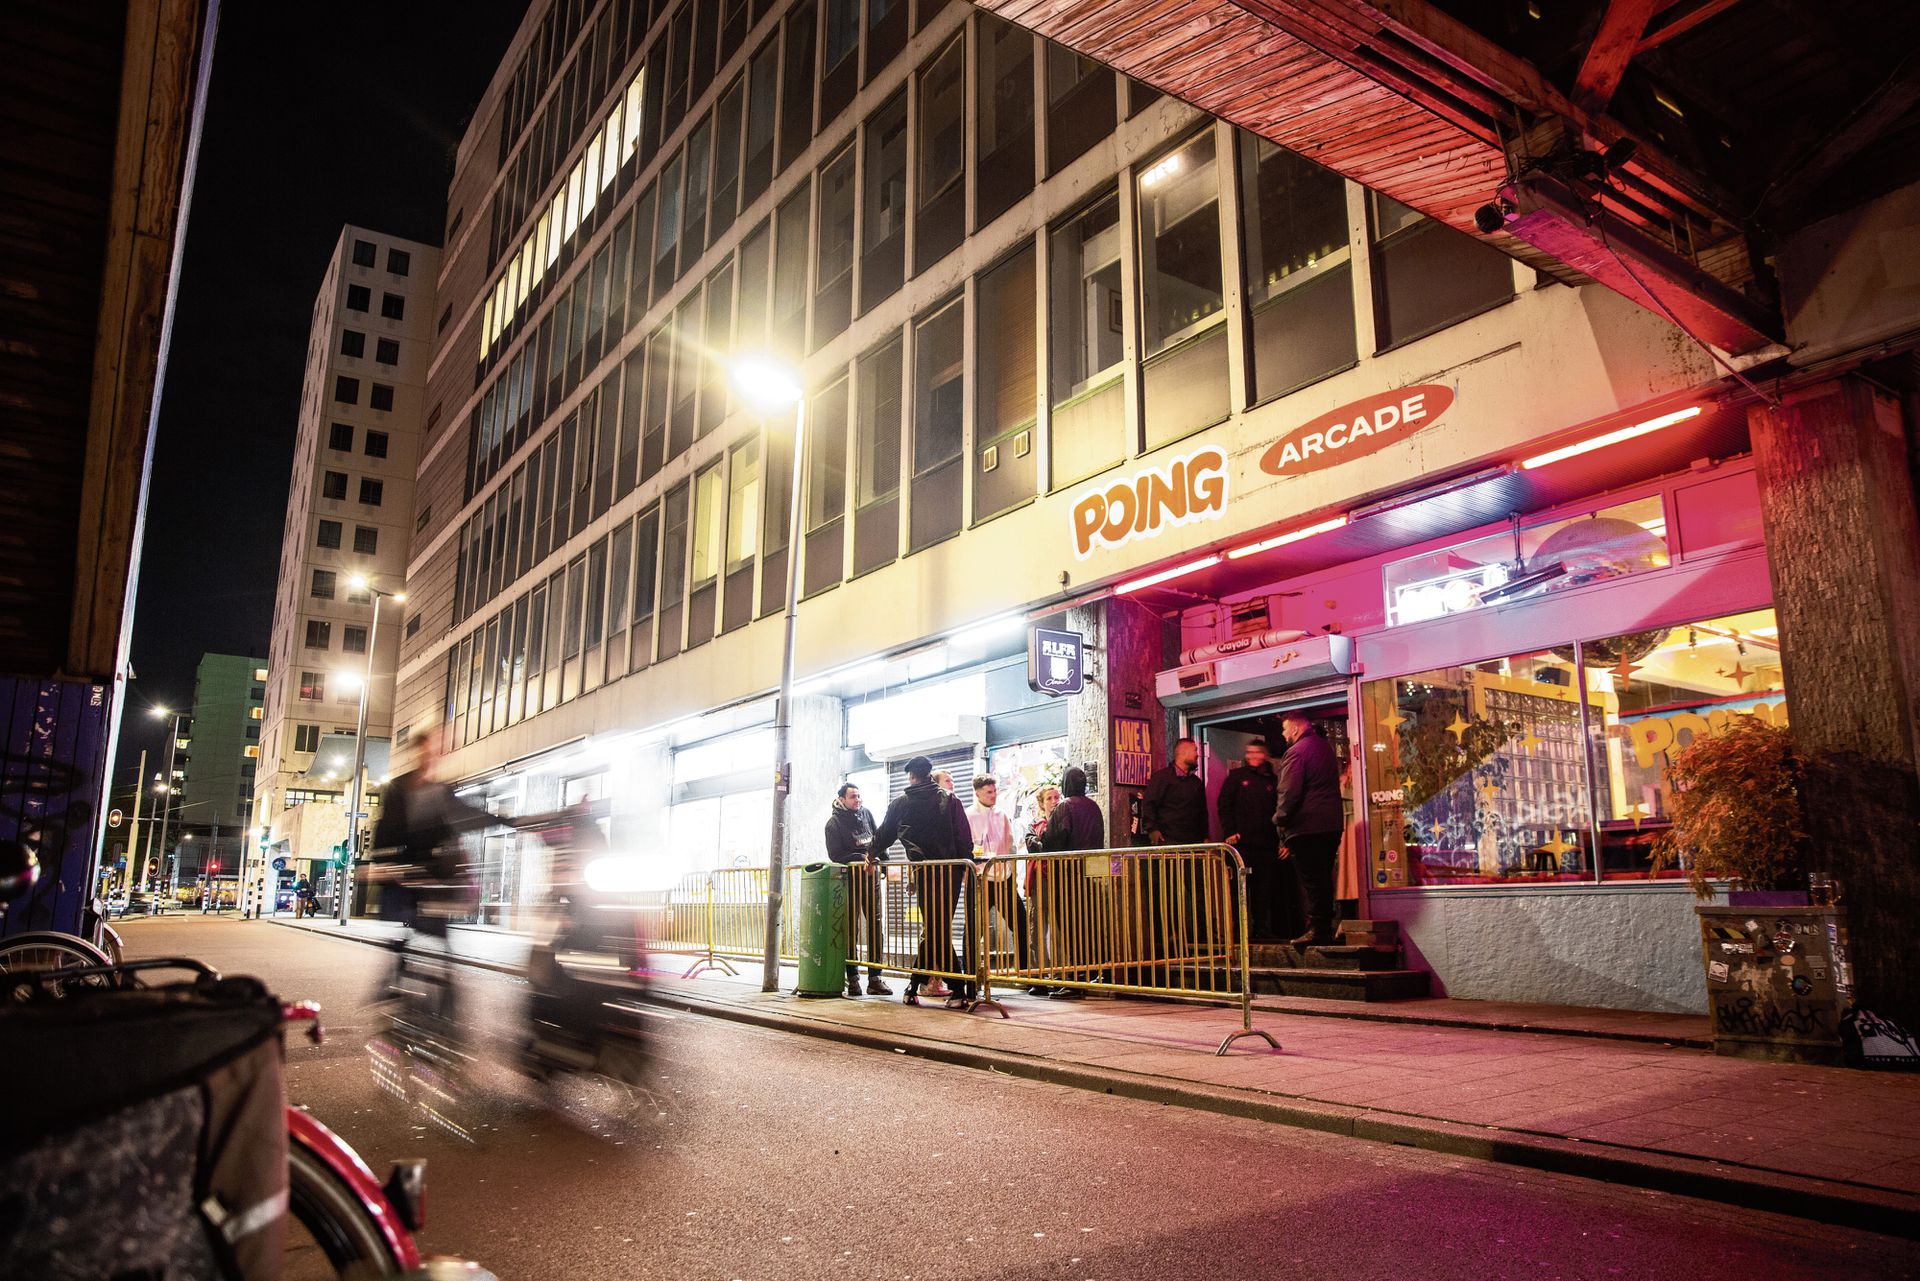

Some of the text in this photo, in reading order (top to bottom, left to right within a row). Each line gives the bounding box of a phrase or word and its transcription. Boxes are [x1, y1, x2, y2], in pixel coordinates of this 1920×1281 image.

[1277, 393, 1427, 468] ARCADE
[1073, 451, 1224, 554] POING
[1218, 638, 1250, 652] Crayola
[1115, 719, 1150, 753] LOVE U
[1371, 789, 1404, 803] POING
